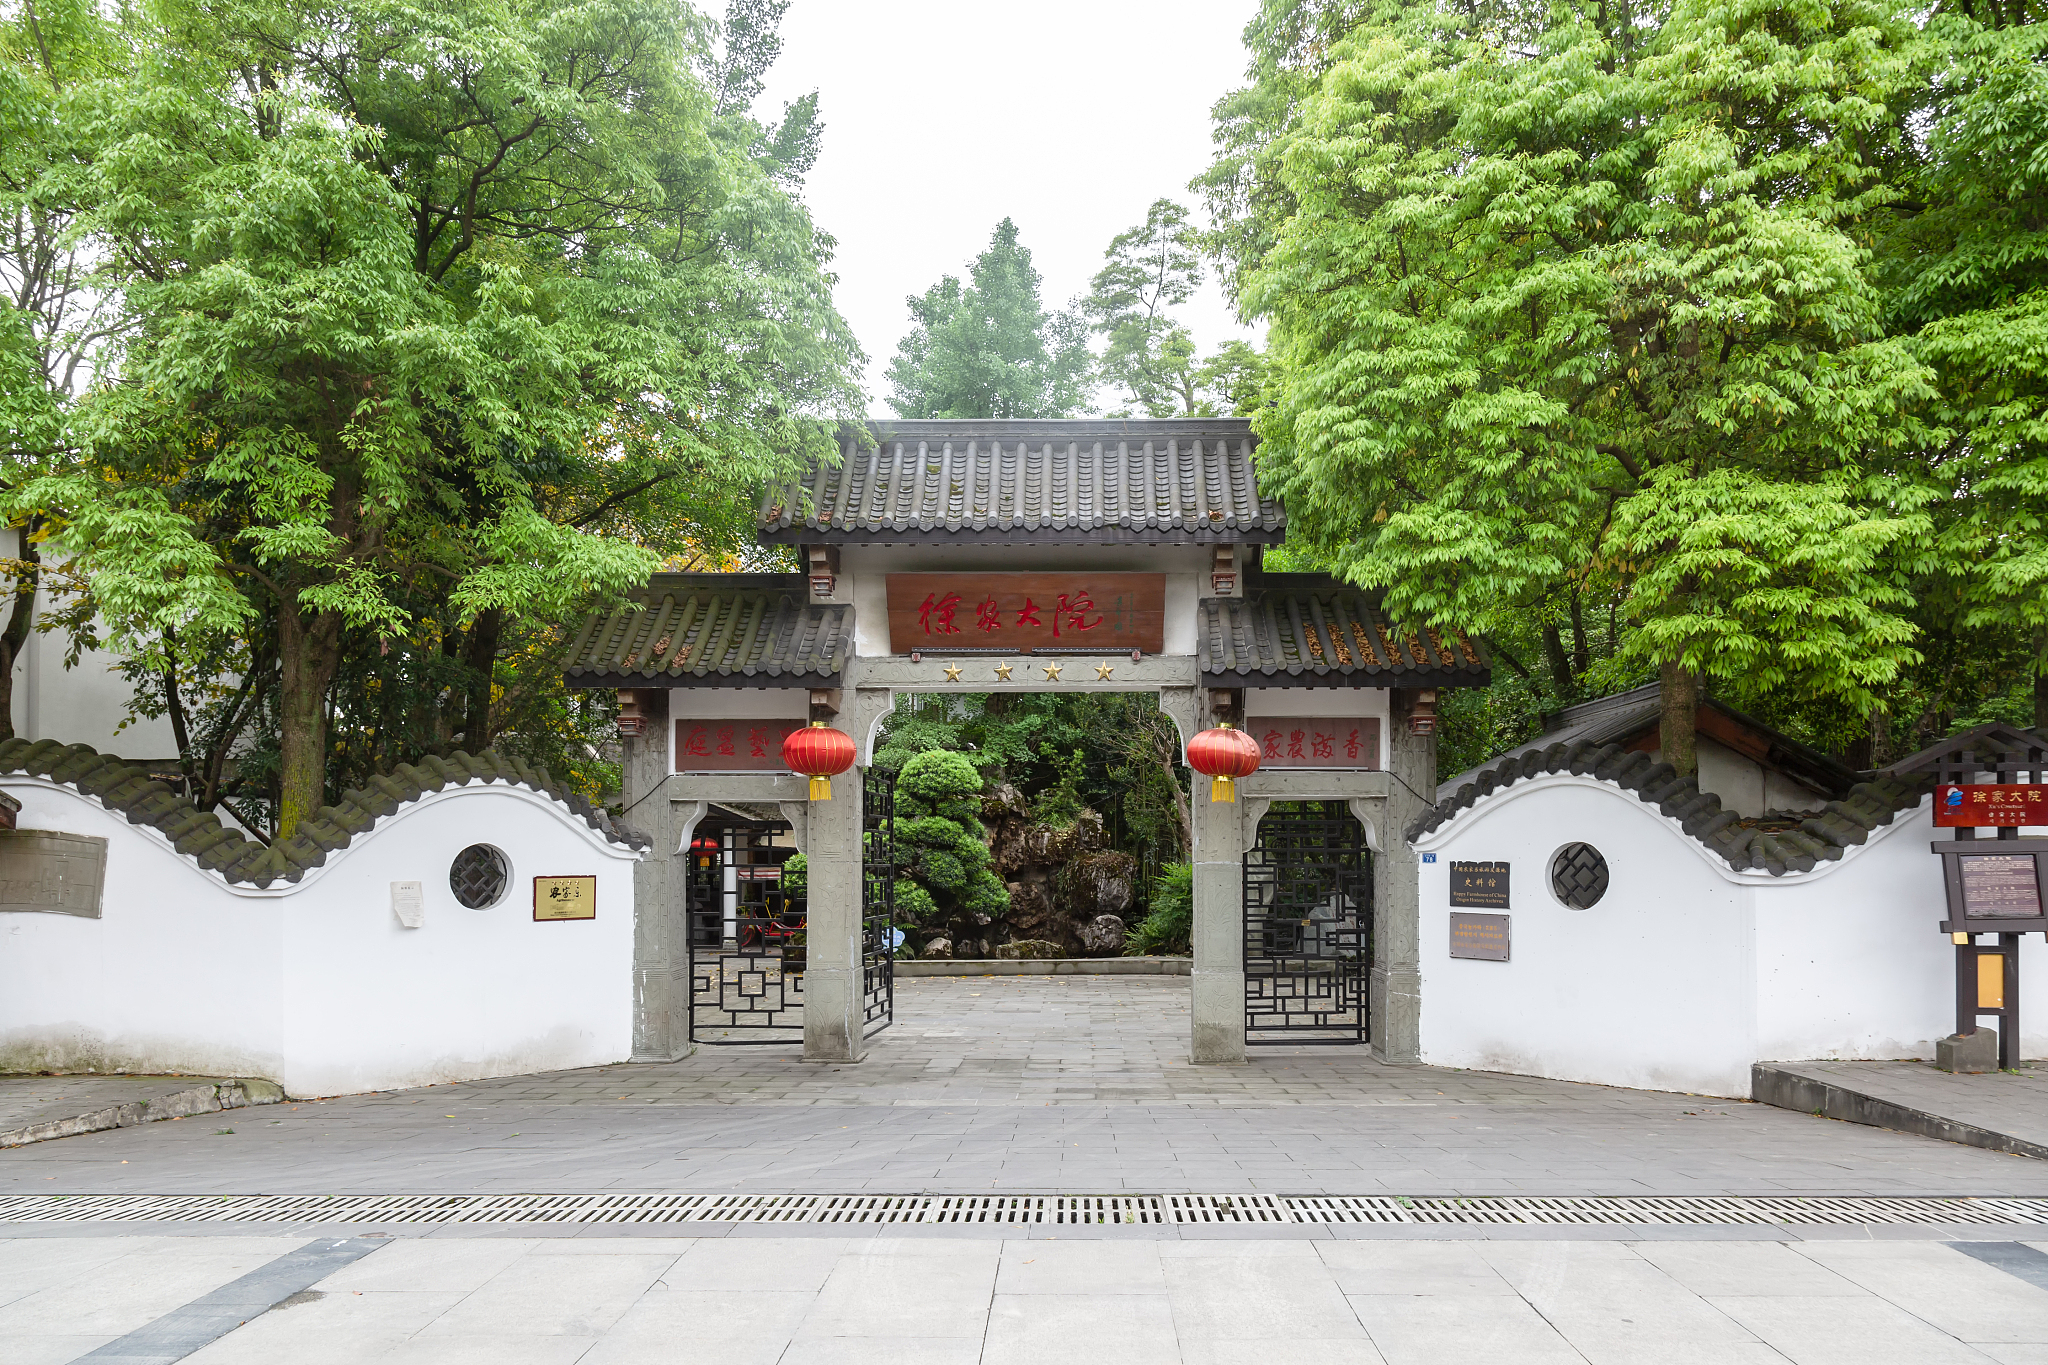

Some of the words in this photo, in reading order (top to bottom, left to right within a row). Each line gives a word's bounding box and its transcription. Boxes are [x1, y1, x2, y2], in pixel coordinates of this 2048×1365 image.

[918, 591, 1103, 638] 徐家大院
[1972, 790, 2042, 803] 徐家大院
[1464, 877, 1497, 888] 史料馆
